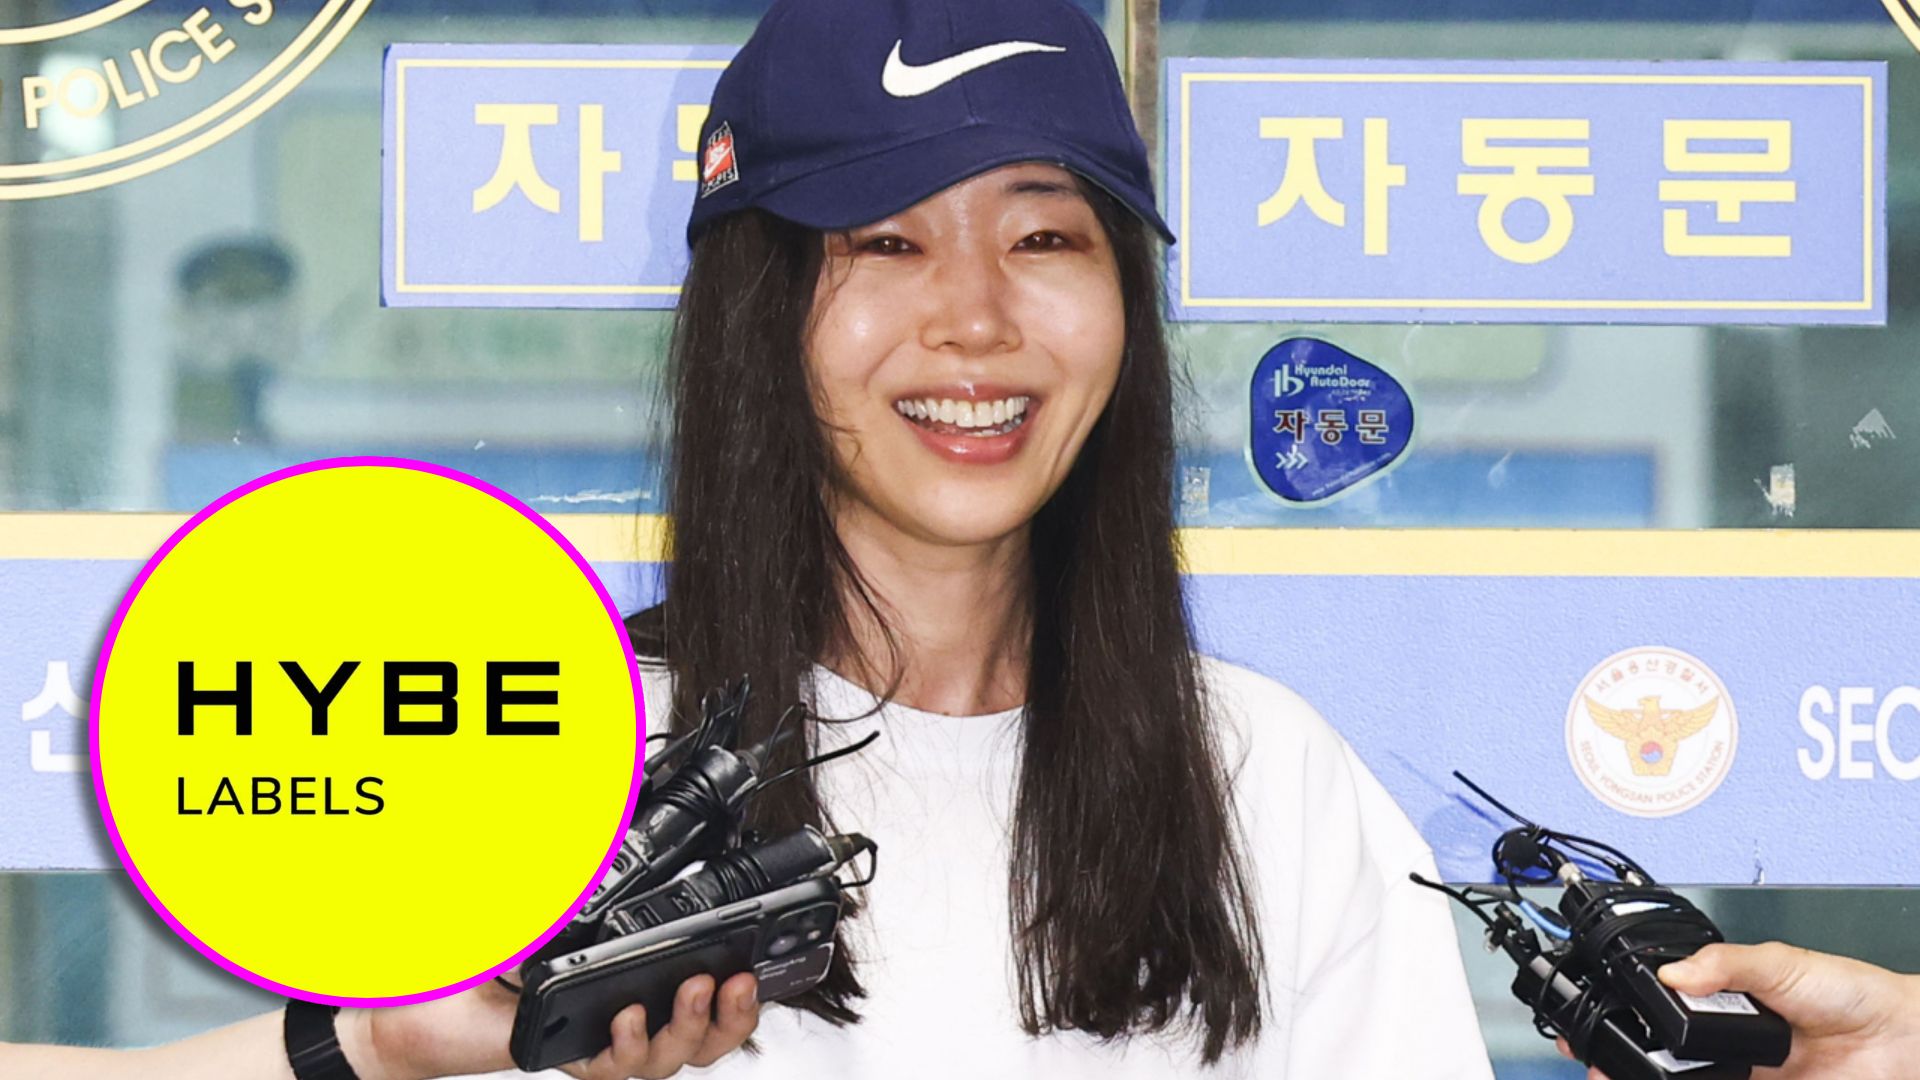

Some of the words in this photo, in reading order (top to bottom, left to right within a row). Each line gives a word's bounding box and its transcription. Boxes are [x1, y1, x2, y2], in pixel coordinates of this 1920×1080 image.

[22, 7, 237, 129] POLICE
[473, 103, 709, 242] 자
[1257, 116, 1796, 264] 자동문
[1272, 409, 1389, 445] 자동문
[1579, 739, 1600, 776] SEOUL
[1600, 775, 1654, 804] YONGSAN
[1656, 780, 1697, 803] POLICE
[1694, 739, 1725, 784] STATION
